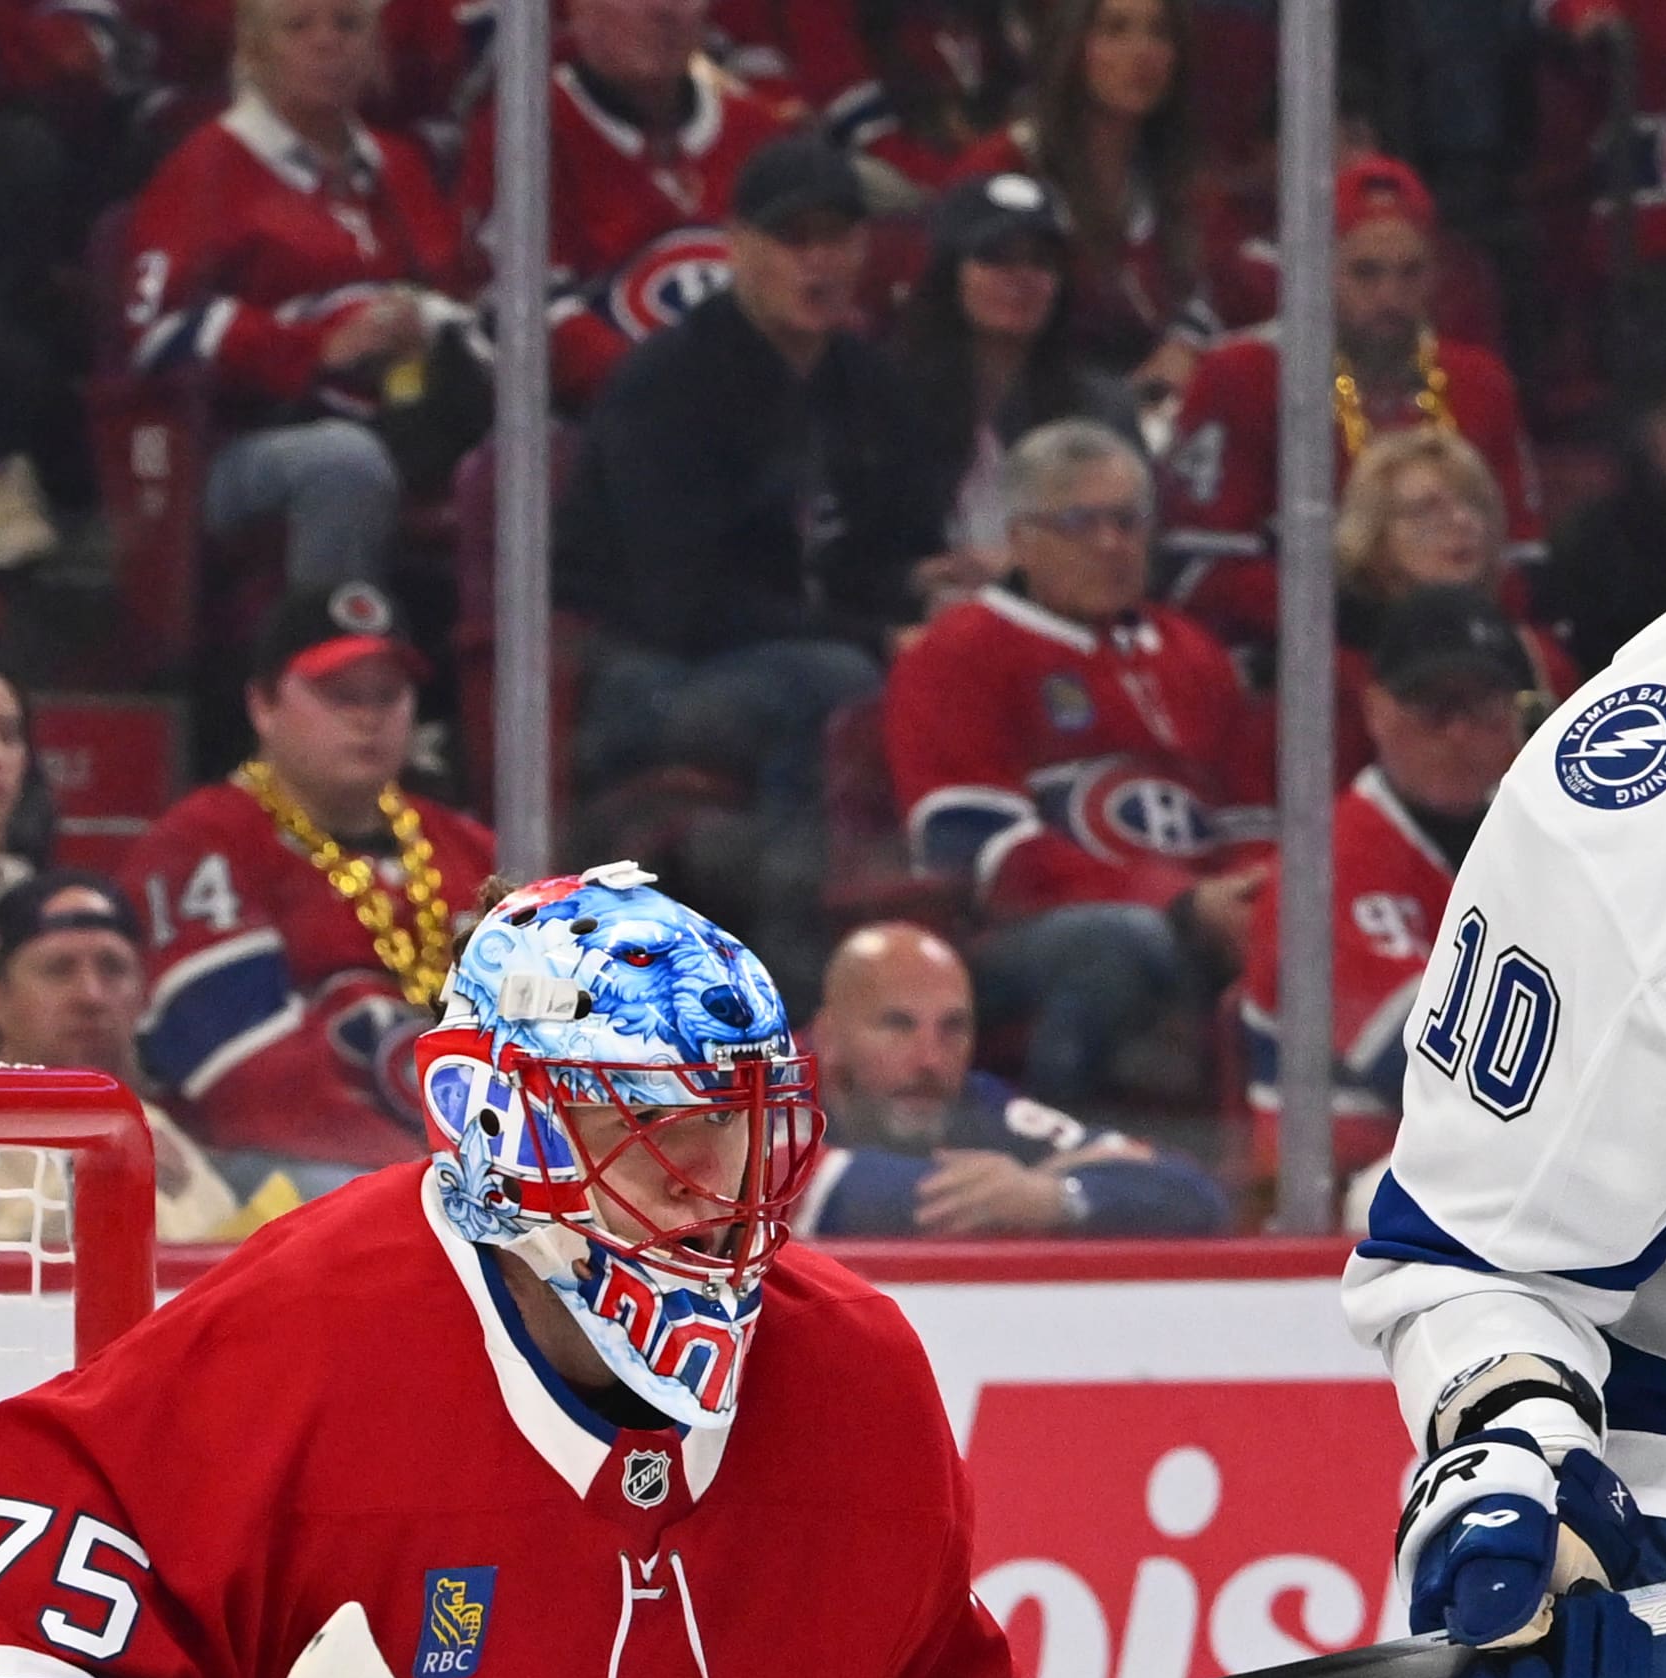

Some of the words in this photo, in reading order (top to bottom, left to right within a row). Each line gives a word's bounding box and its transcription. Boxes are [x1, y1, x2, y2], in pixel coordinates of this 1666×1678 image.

[1564, 690, 1631, 743] TAMPA
[145, 851, 242, 947] 14
[1415, 904, 1562, 1123] 10
[630, 1460, 664, 1497] LNH
[422, 1648, 474, 1675] RBC
